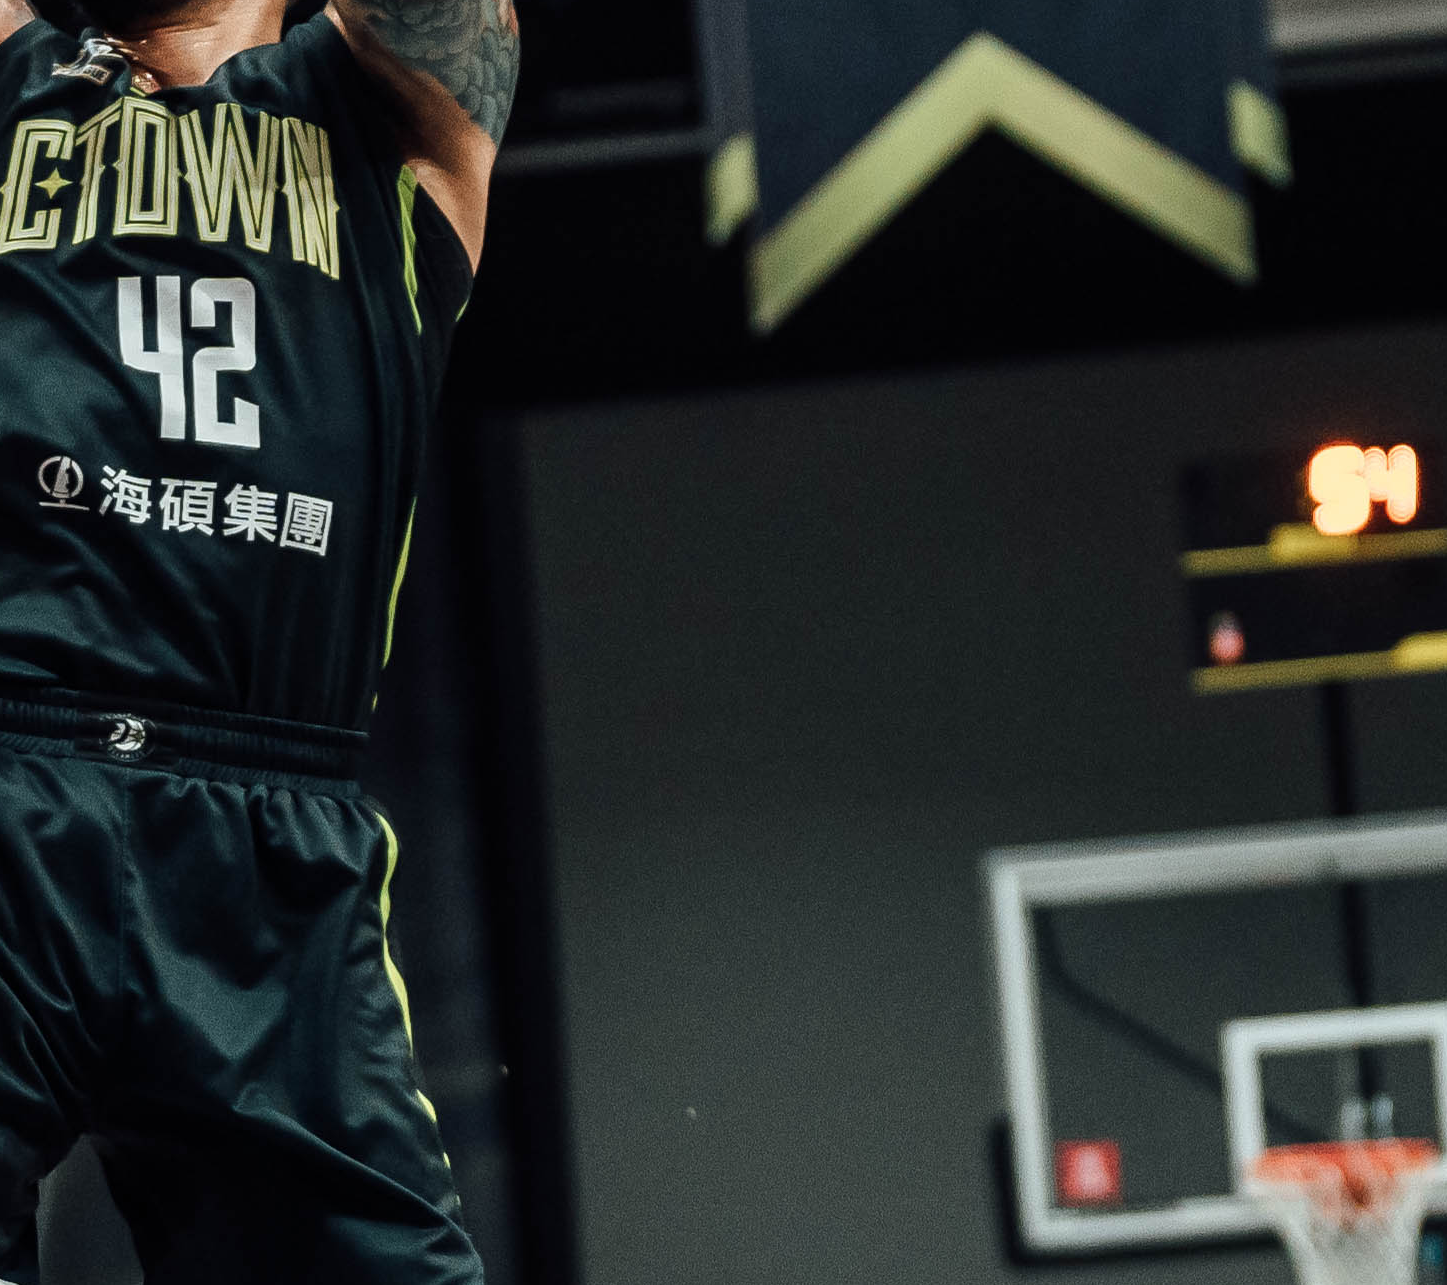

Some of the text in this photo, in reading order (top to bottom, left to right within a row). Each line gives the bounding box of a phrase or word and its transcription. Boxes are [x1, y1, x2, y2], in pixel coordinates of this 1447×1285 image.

[117, 274, 261, 450] 42
[98, 466, 334, 556] 海碩集團
